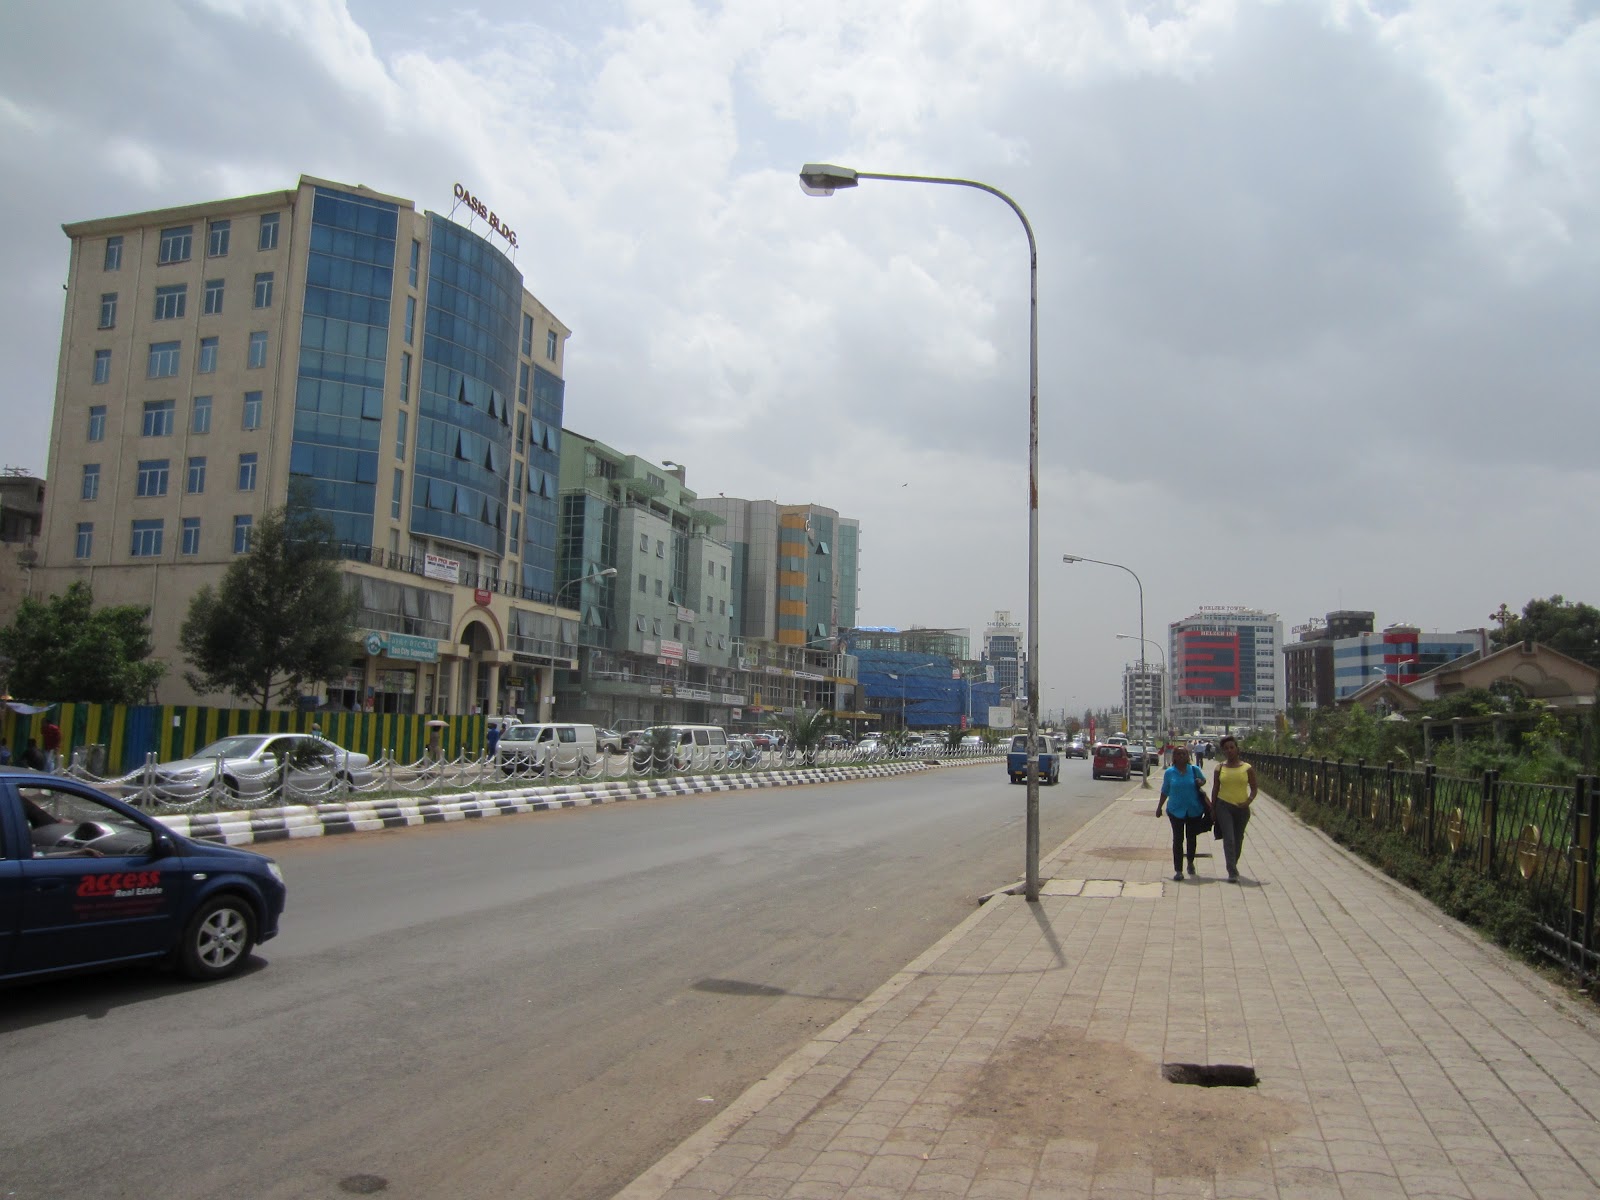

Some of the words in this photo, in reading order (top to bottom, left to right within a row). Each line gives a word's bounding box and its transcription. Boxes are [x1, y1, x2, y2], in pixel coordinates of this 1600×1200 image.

[453, 182, 487, 220] OASIS
[76, 870, 160, 897] access
[114, 889, 134, 897] Real
[136, 886, 163, 895] Estate
